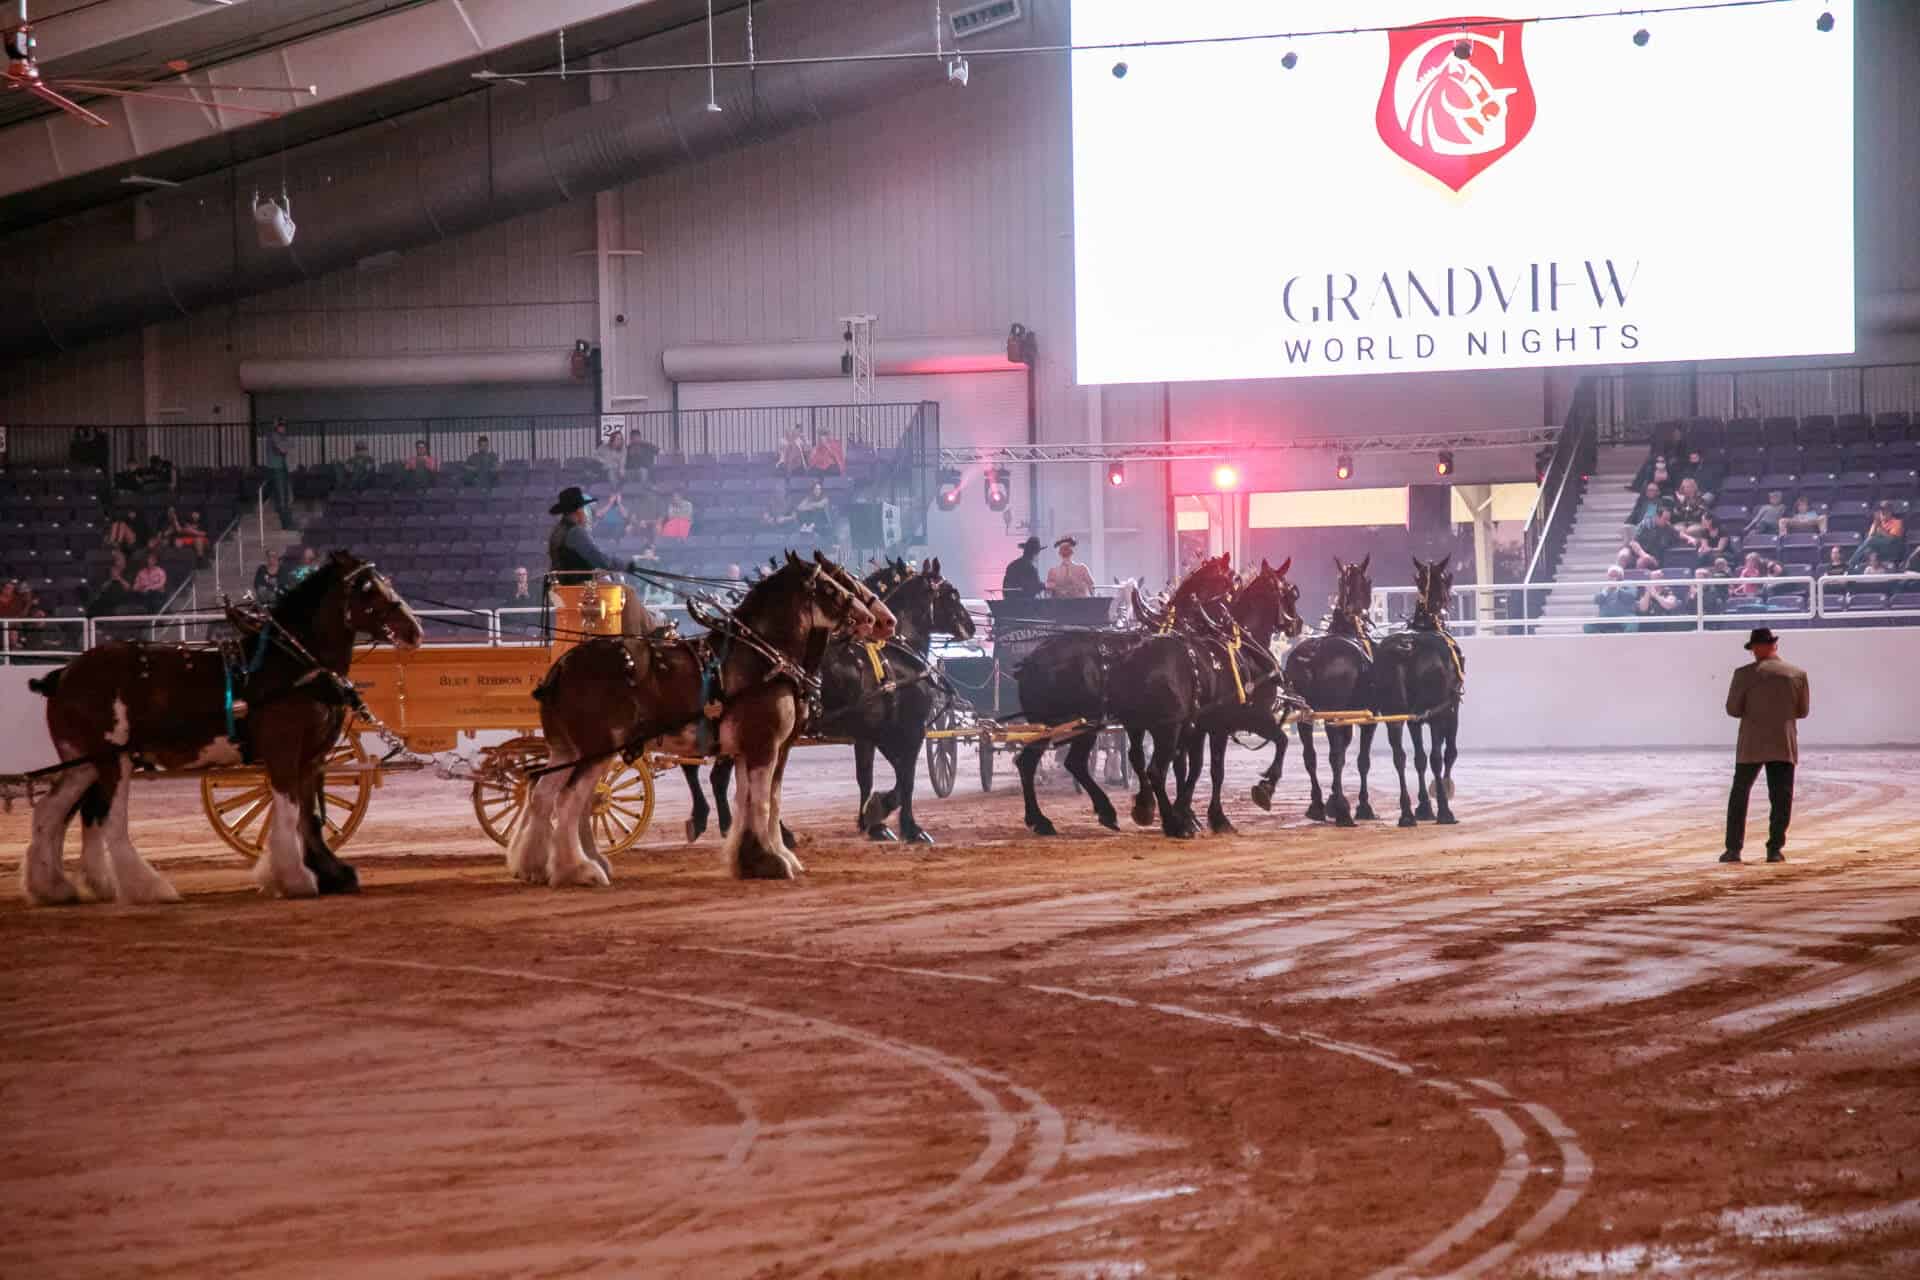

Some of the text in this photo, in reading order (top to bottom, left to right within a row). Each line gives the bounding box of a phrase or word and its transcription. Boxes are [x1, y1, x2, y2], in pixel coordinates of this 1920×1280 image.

[1284, 324, 1640, 364] WORLD NIGHTS
[477, 675, 522, 686] RIBBON
